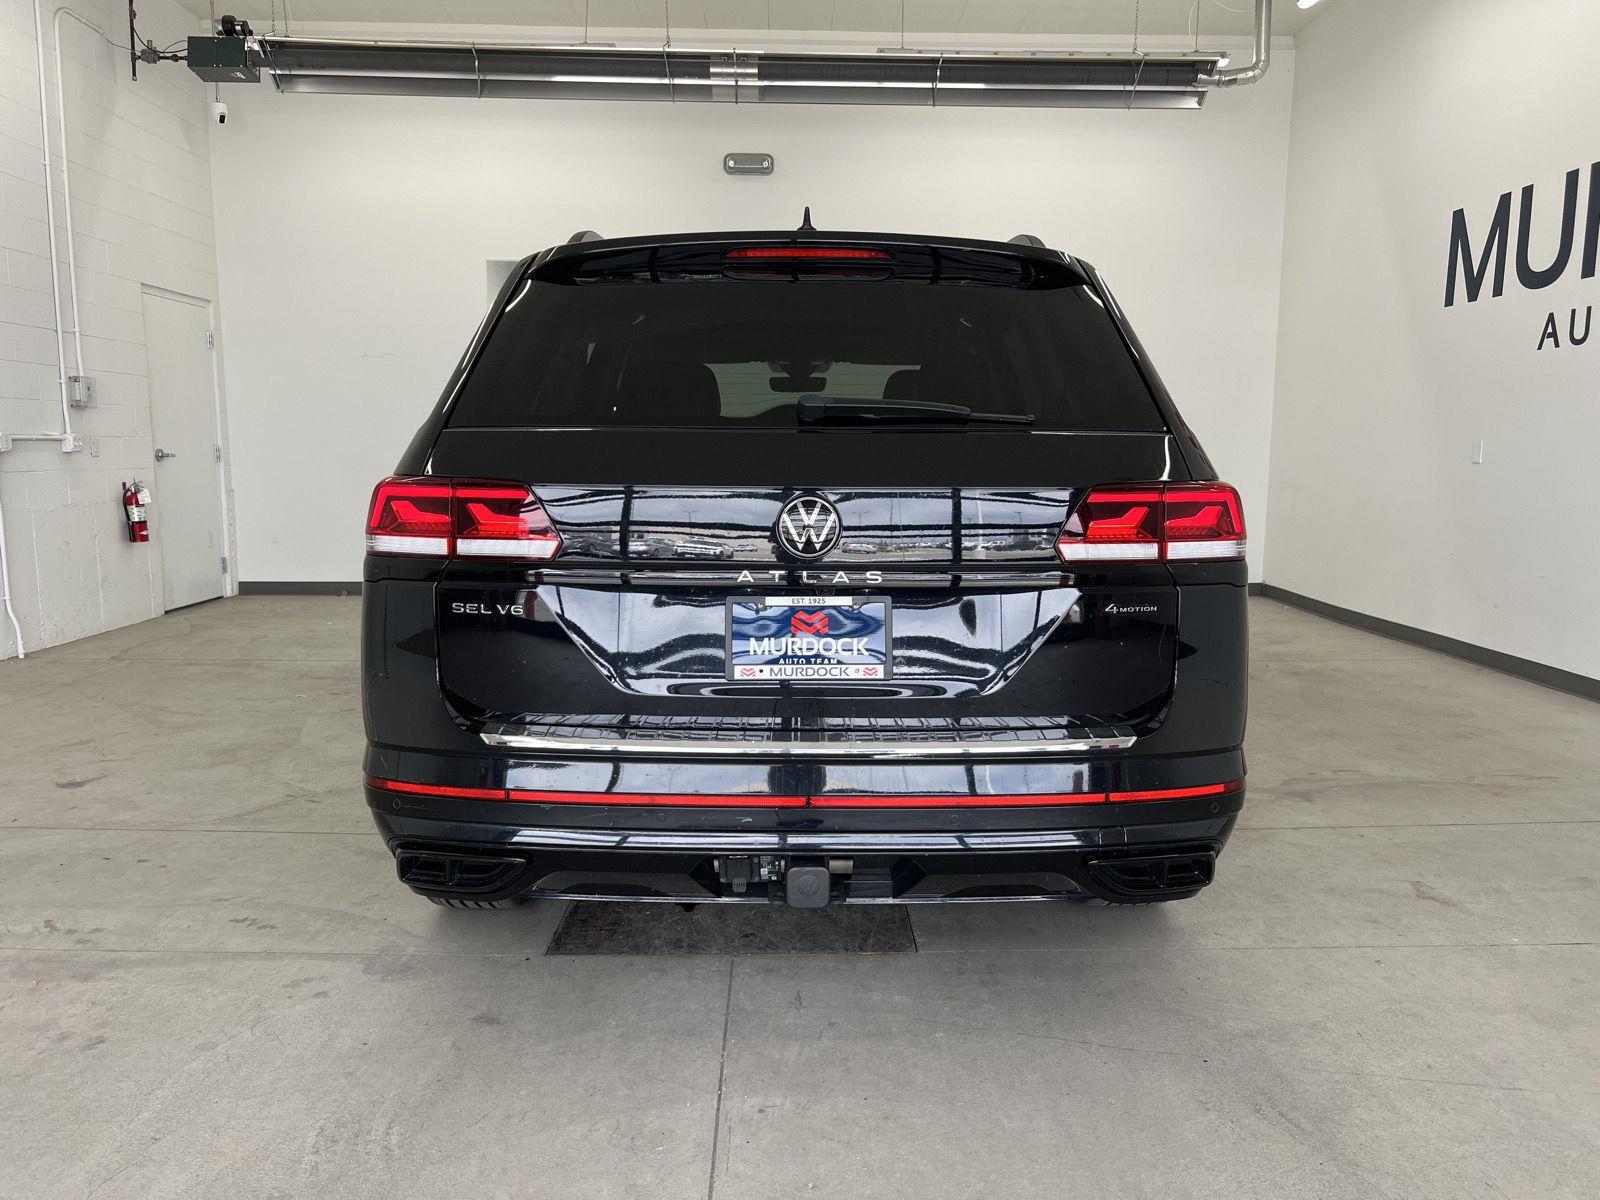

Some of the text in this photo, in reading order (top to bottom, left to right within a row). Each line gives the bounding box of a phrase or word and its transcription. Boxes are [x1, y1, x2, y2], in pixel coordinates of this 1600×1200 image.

[736, 570, 883, 584] ATLAS
[451, 602, 524, 615] SEL V6
[749, 637, 870, 656] MURDOCK
[769, 666, 850, 677] MURDOCK
